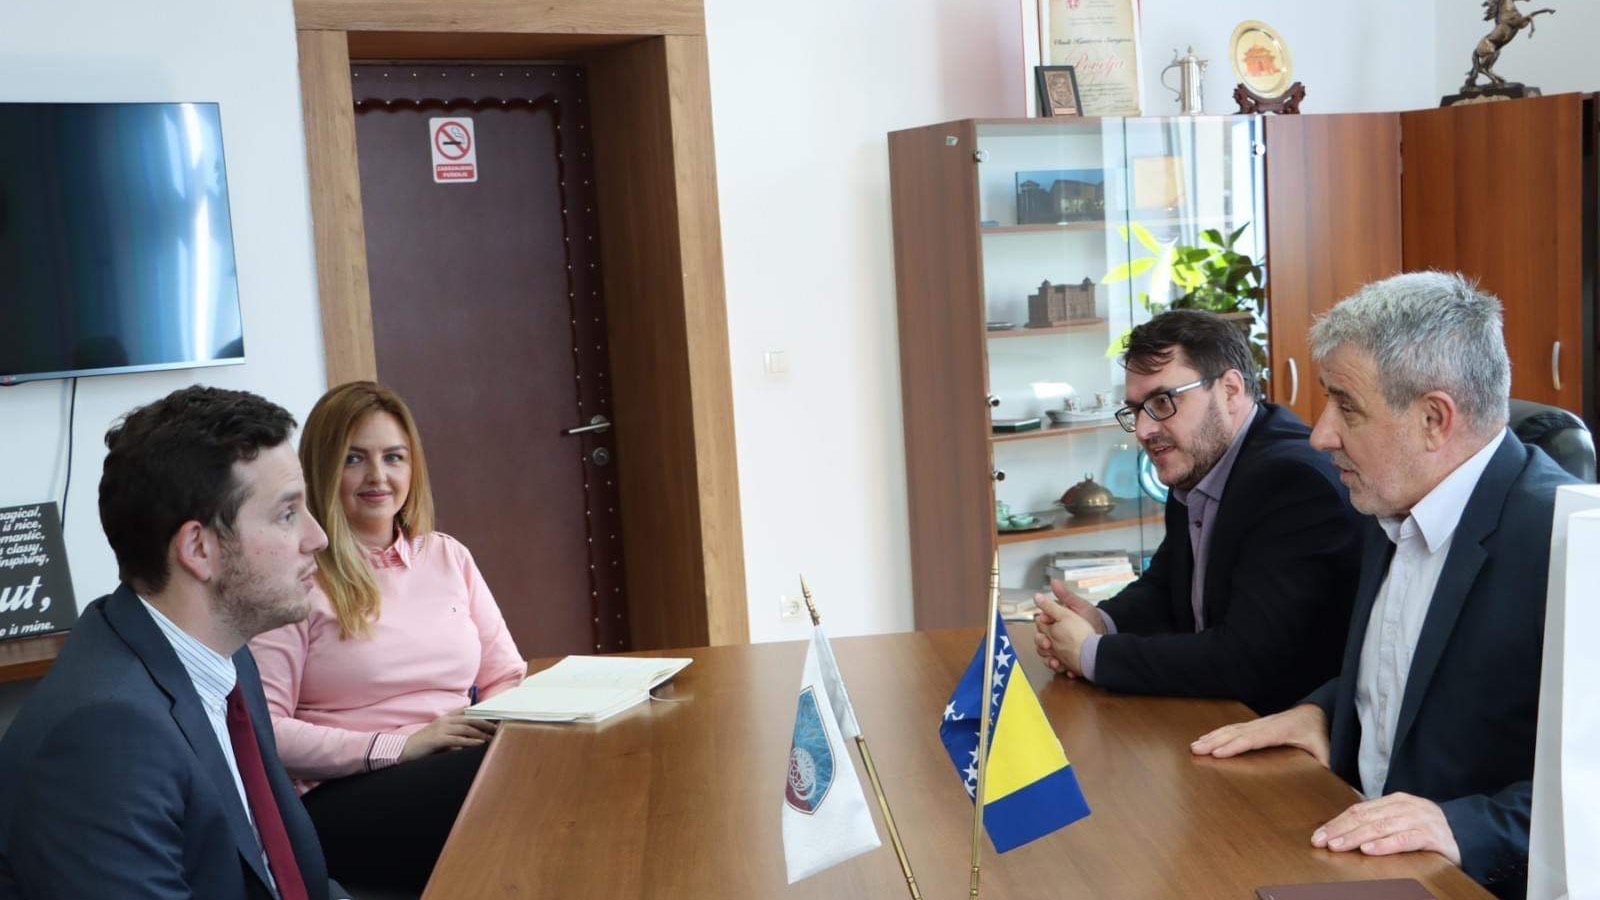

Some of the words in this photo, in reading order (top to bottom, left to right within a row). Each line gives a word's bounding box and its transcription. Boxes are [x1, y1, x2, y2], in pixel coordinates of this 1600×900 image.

[2, 521, 12, 532] is
[14, 518, 42, 531] nice,
[0, 529, 45, 543] mantic,
[6, 543, 43, 556] classy,
[0, 576, 51, 612] ut,
[9, 623, 18, 635] is
[20, 620, 55, 634] mine.
